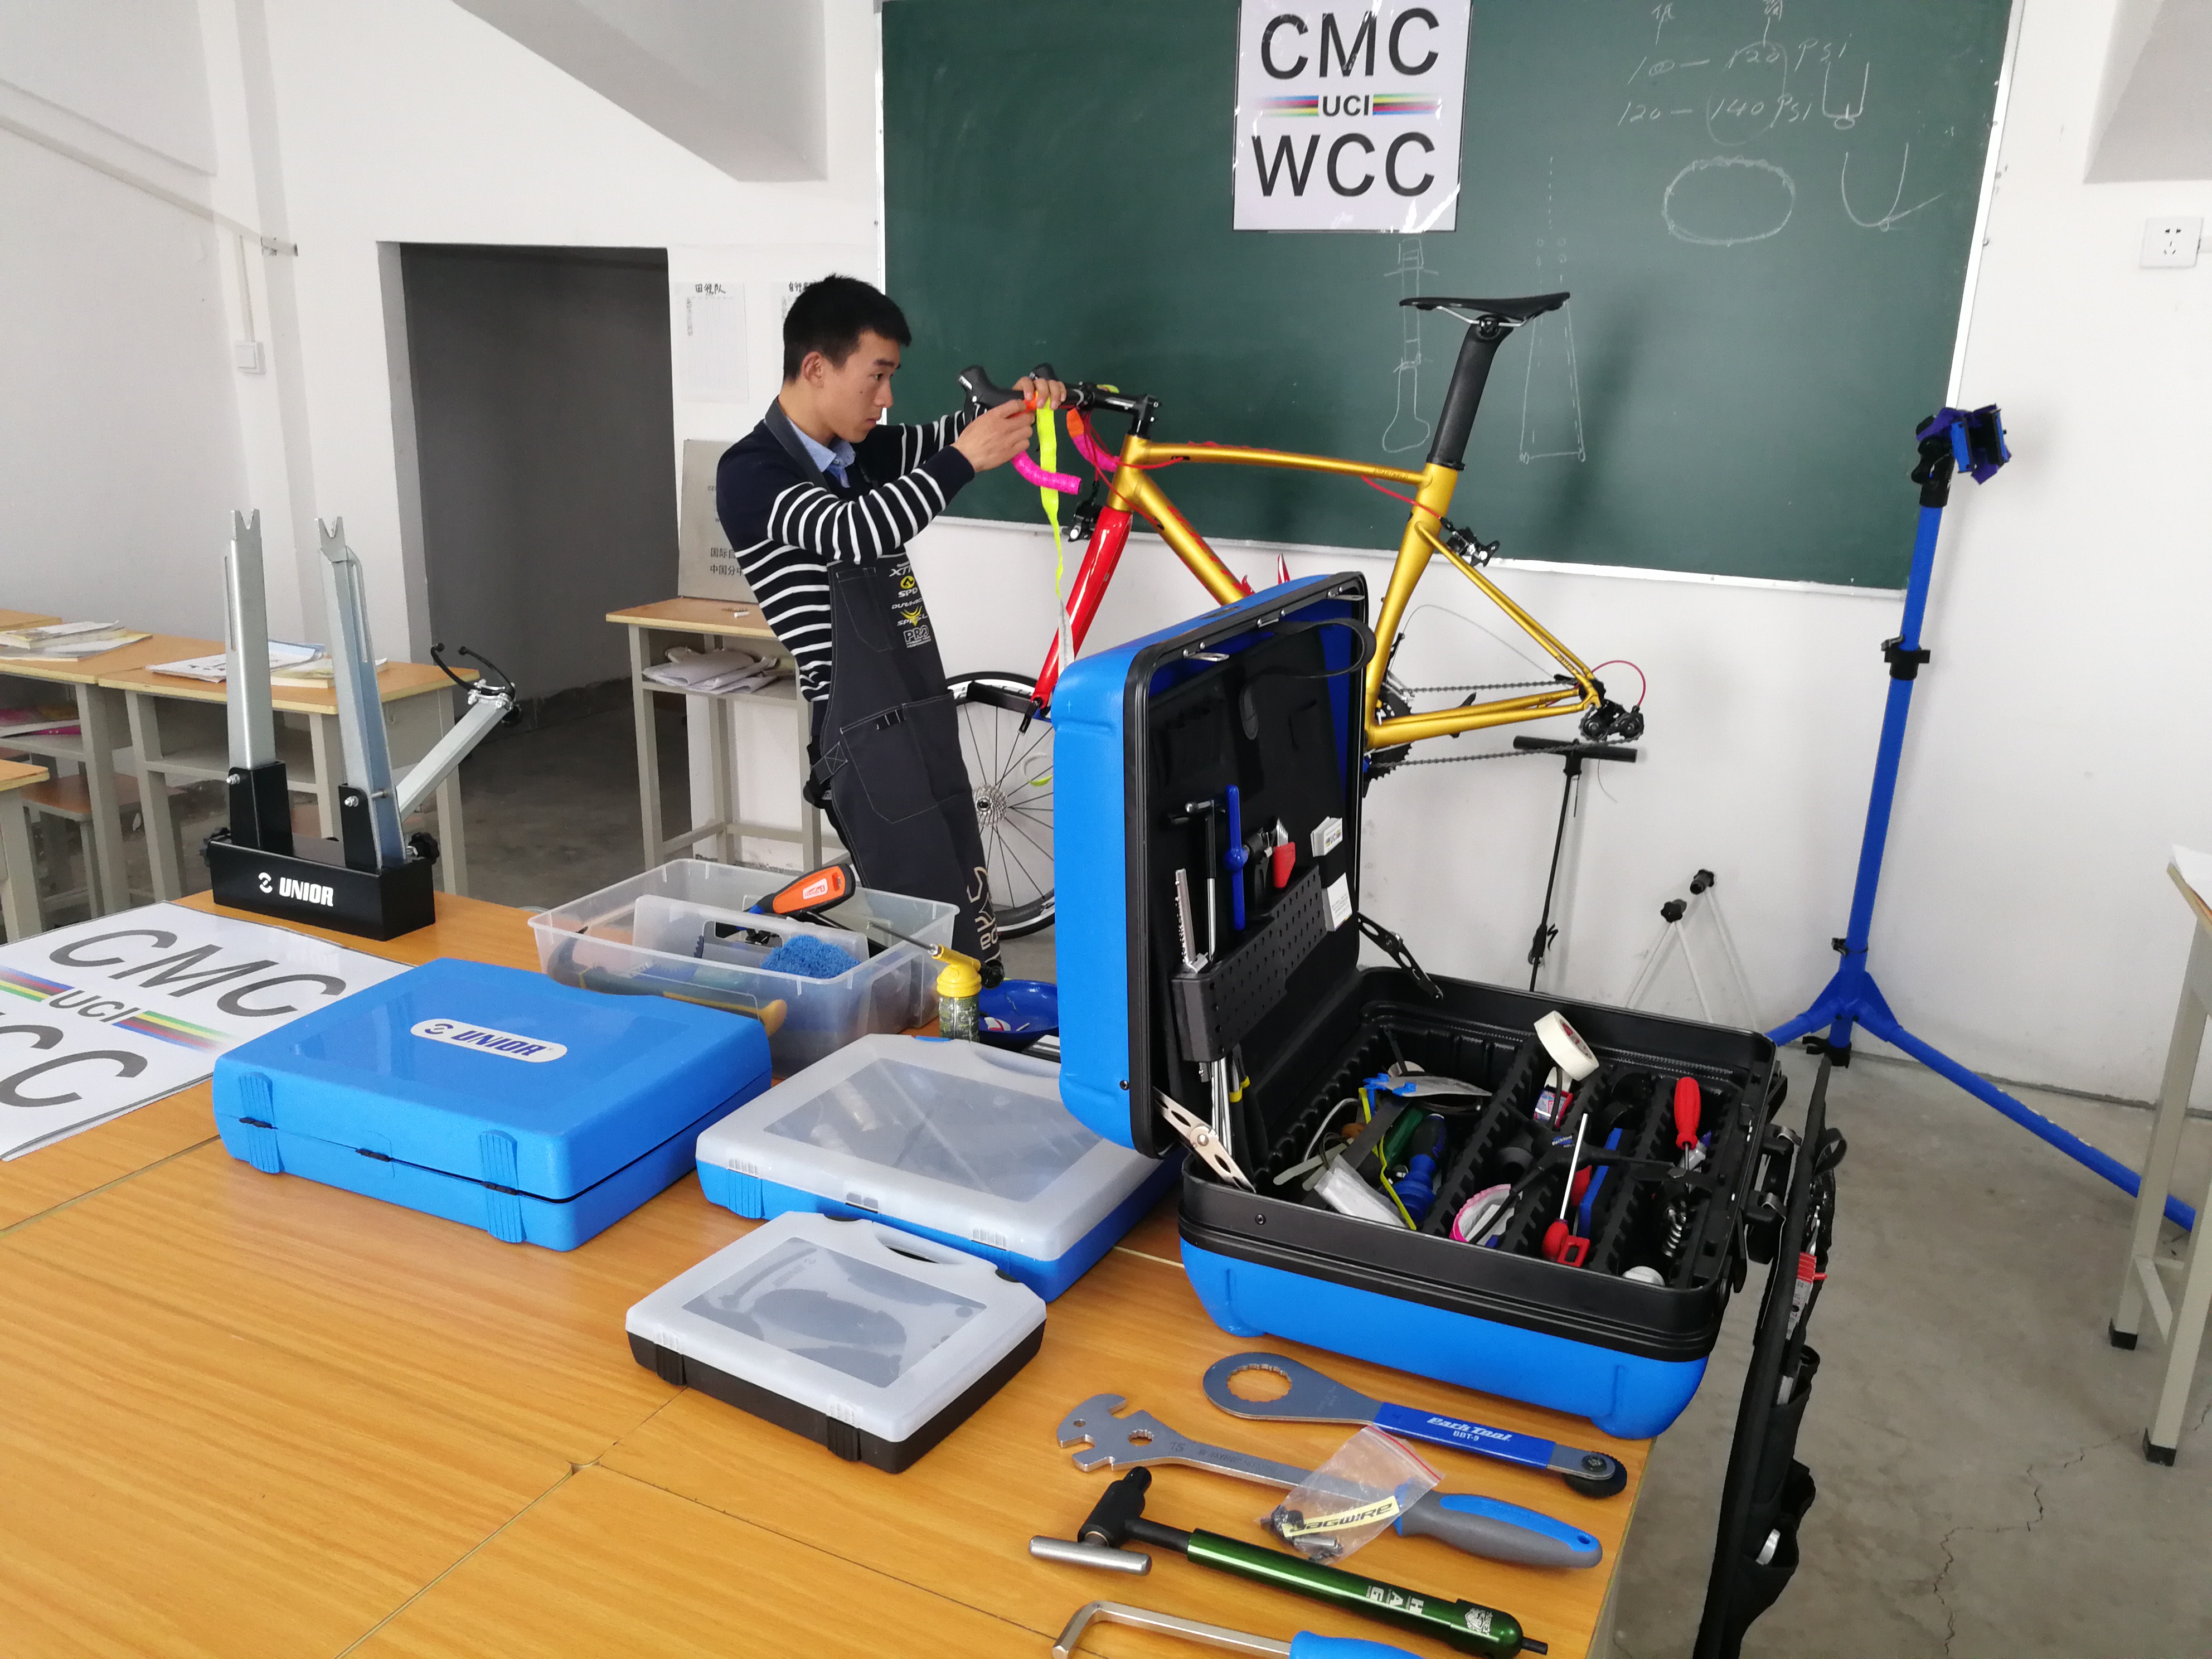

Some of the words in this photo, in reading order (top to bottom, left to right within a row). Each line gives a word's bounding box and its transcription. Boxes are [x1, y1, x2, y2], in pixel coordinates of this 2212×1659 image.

[1261, 8, 1439, 79] CMC
[1322, 95, 1370, 117] UCI
[1618, 101, 1661, 126] 120
[1711, 98, 1764, 120] 140
[1251, 132, 1435, 197] WCC
[898, 587, 918, 598] SPD
[903, 625, 930, 642] PRO
[279, 877, 334, 907] UNIOR
[50, 929, 347, 1017] CMC
[49, 990, 141, 1022] UCI
[450, 1030, 547, 1056] UNIOR
[1427, 1417, 1471, 1432] Park
[1471, 1427, 1512, 1442] Tool
[1453, 1430, 1479, 1442] BBT-9
